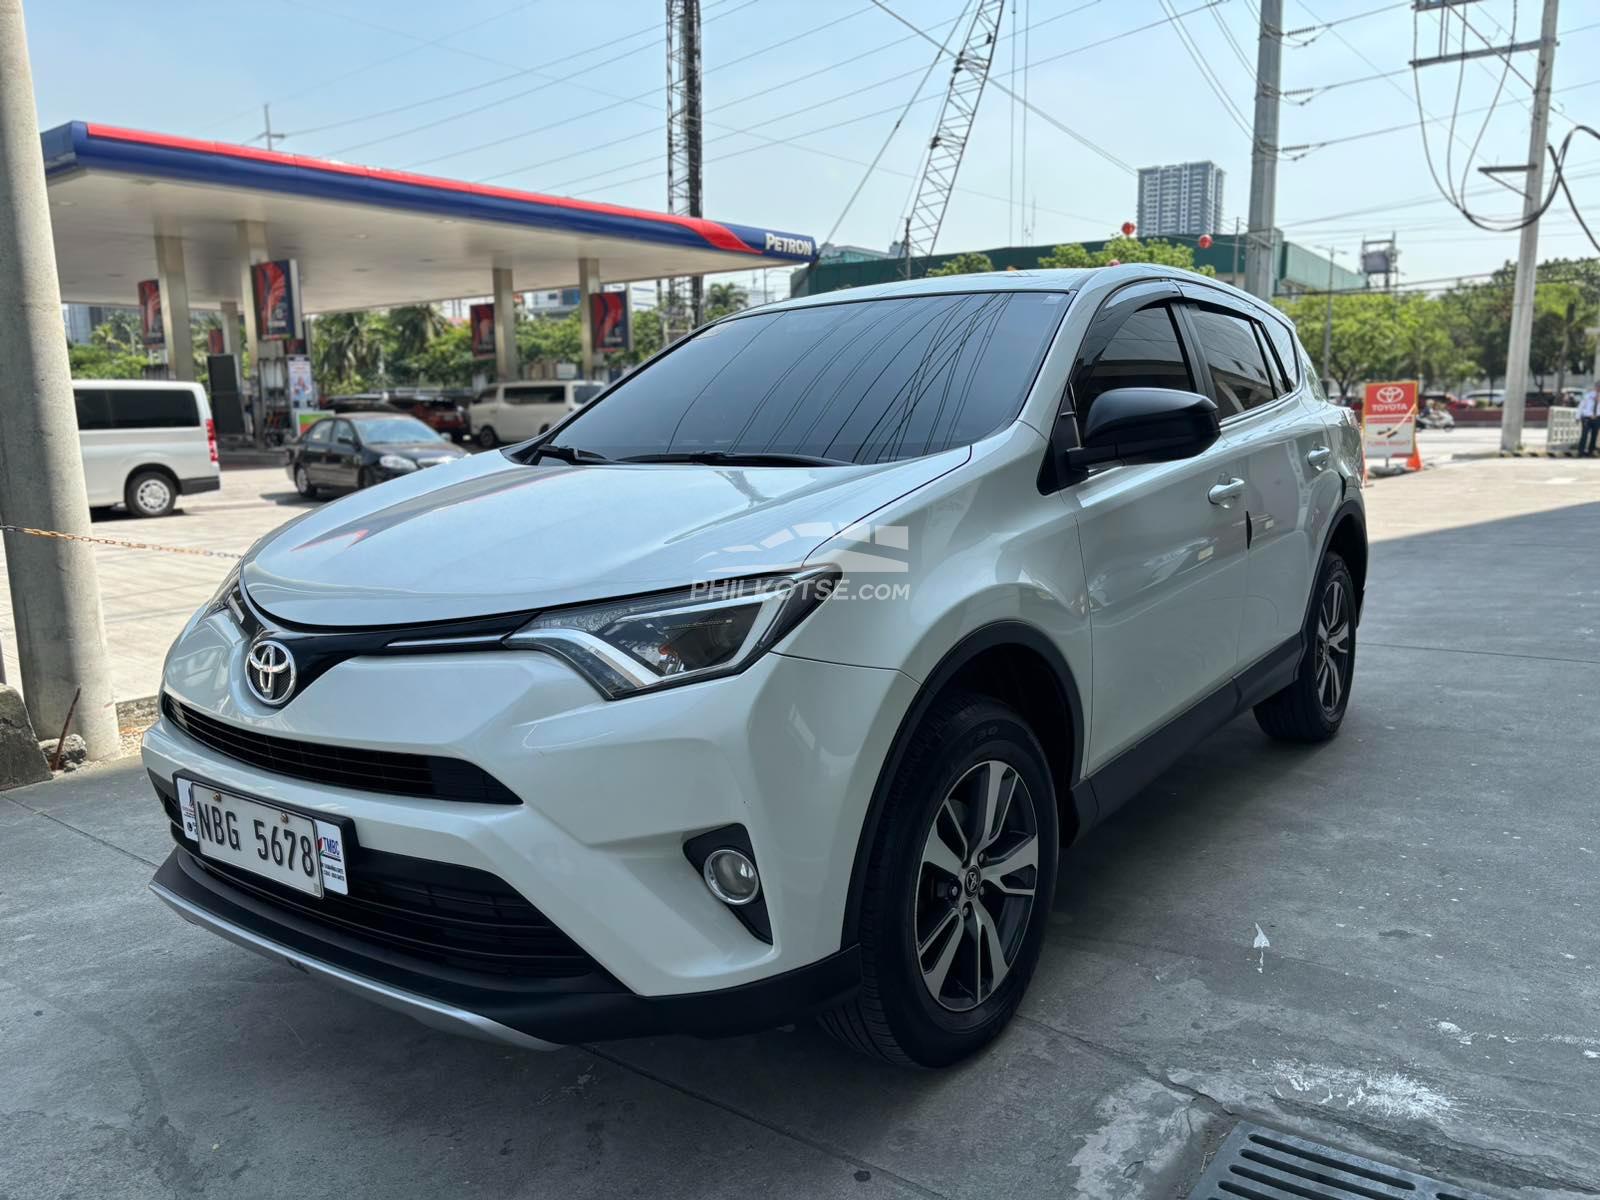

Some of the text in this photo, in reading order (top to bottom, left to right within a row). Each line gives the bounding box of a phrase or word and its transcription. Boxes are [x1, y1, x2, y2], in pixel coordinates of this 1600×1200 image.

[765, 232, 812, 256] PETRON
[1371, 403, 1408, 412] TOYOTA
[197, 801, 315, 878] NBG 5678
